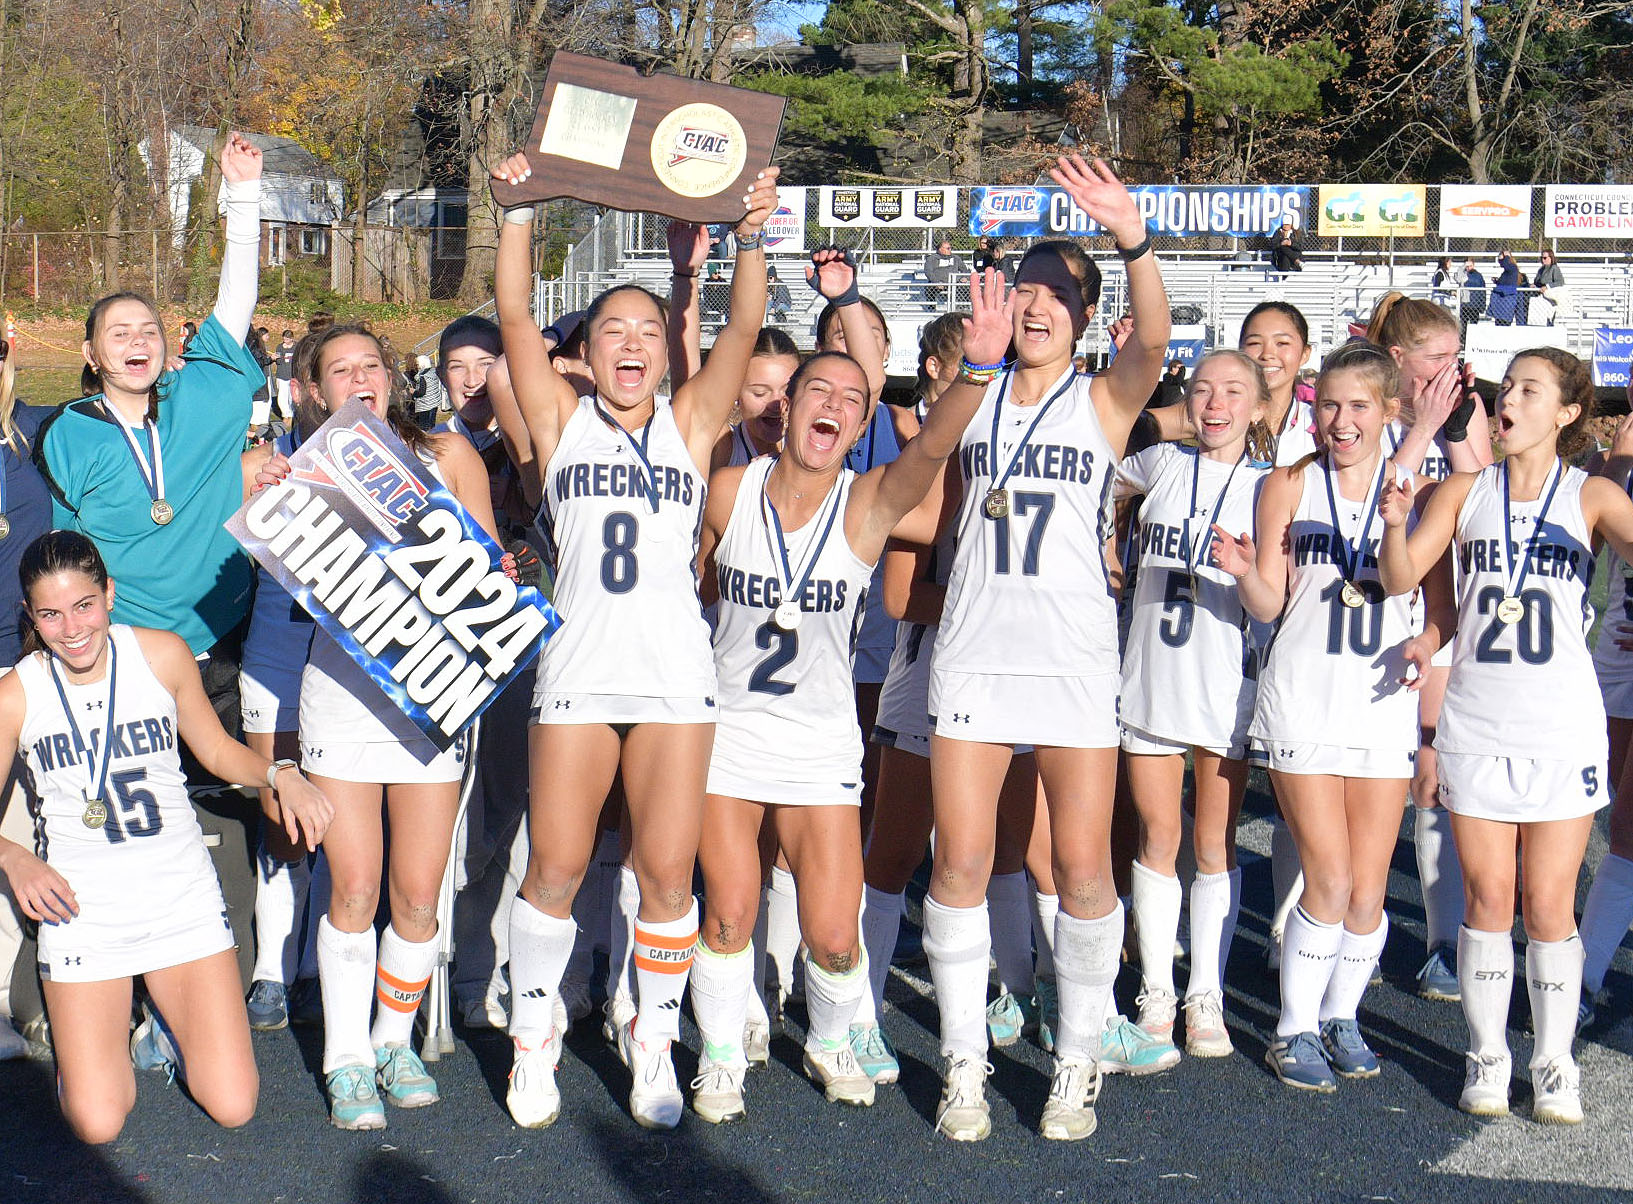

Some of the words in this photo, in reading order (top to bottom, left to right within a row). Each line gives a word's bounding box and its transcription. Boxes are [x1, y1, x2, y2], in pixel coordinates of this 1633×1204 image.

[683, 132, 729, 153] CIAC
[991, 195, 1036, 211] CIAC
[1050, 192, 1300, 232] CHPIONSHIPS
[1555, 202, 1633, 214] PROBLE
[1555, 215, 1633, 227] GAMBLIN
[1177, 347, 1193, 358] Fit
[1608, 332, 1633, 344] Leo
[1603, 372, 1629, 383] 860-
[340, 437, 429, 523] CIAC
[600, 510, 640, 595] 8
[384, 508, 549, 681] 2024
[719, 563, 848, 613] WRECERS
[245, 480, 498, 738] CHAMPION
[1158, 570, 1198, 649] 5
[1320, 577, 1385, 657] 10
[1475, 584, 1554, 666] 20
[748, 619, 799, 697] 2
[1581, 764, 1598, 798] S
[1475, 969, 1508, 981] STX
[1532, 979, 1566, 992] STX
